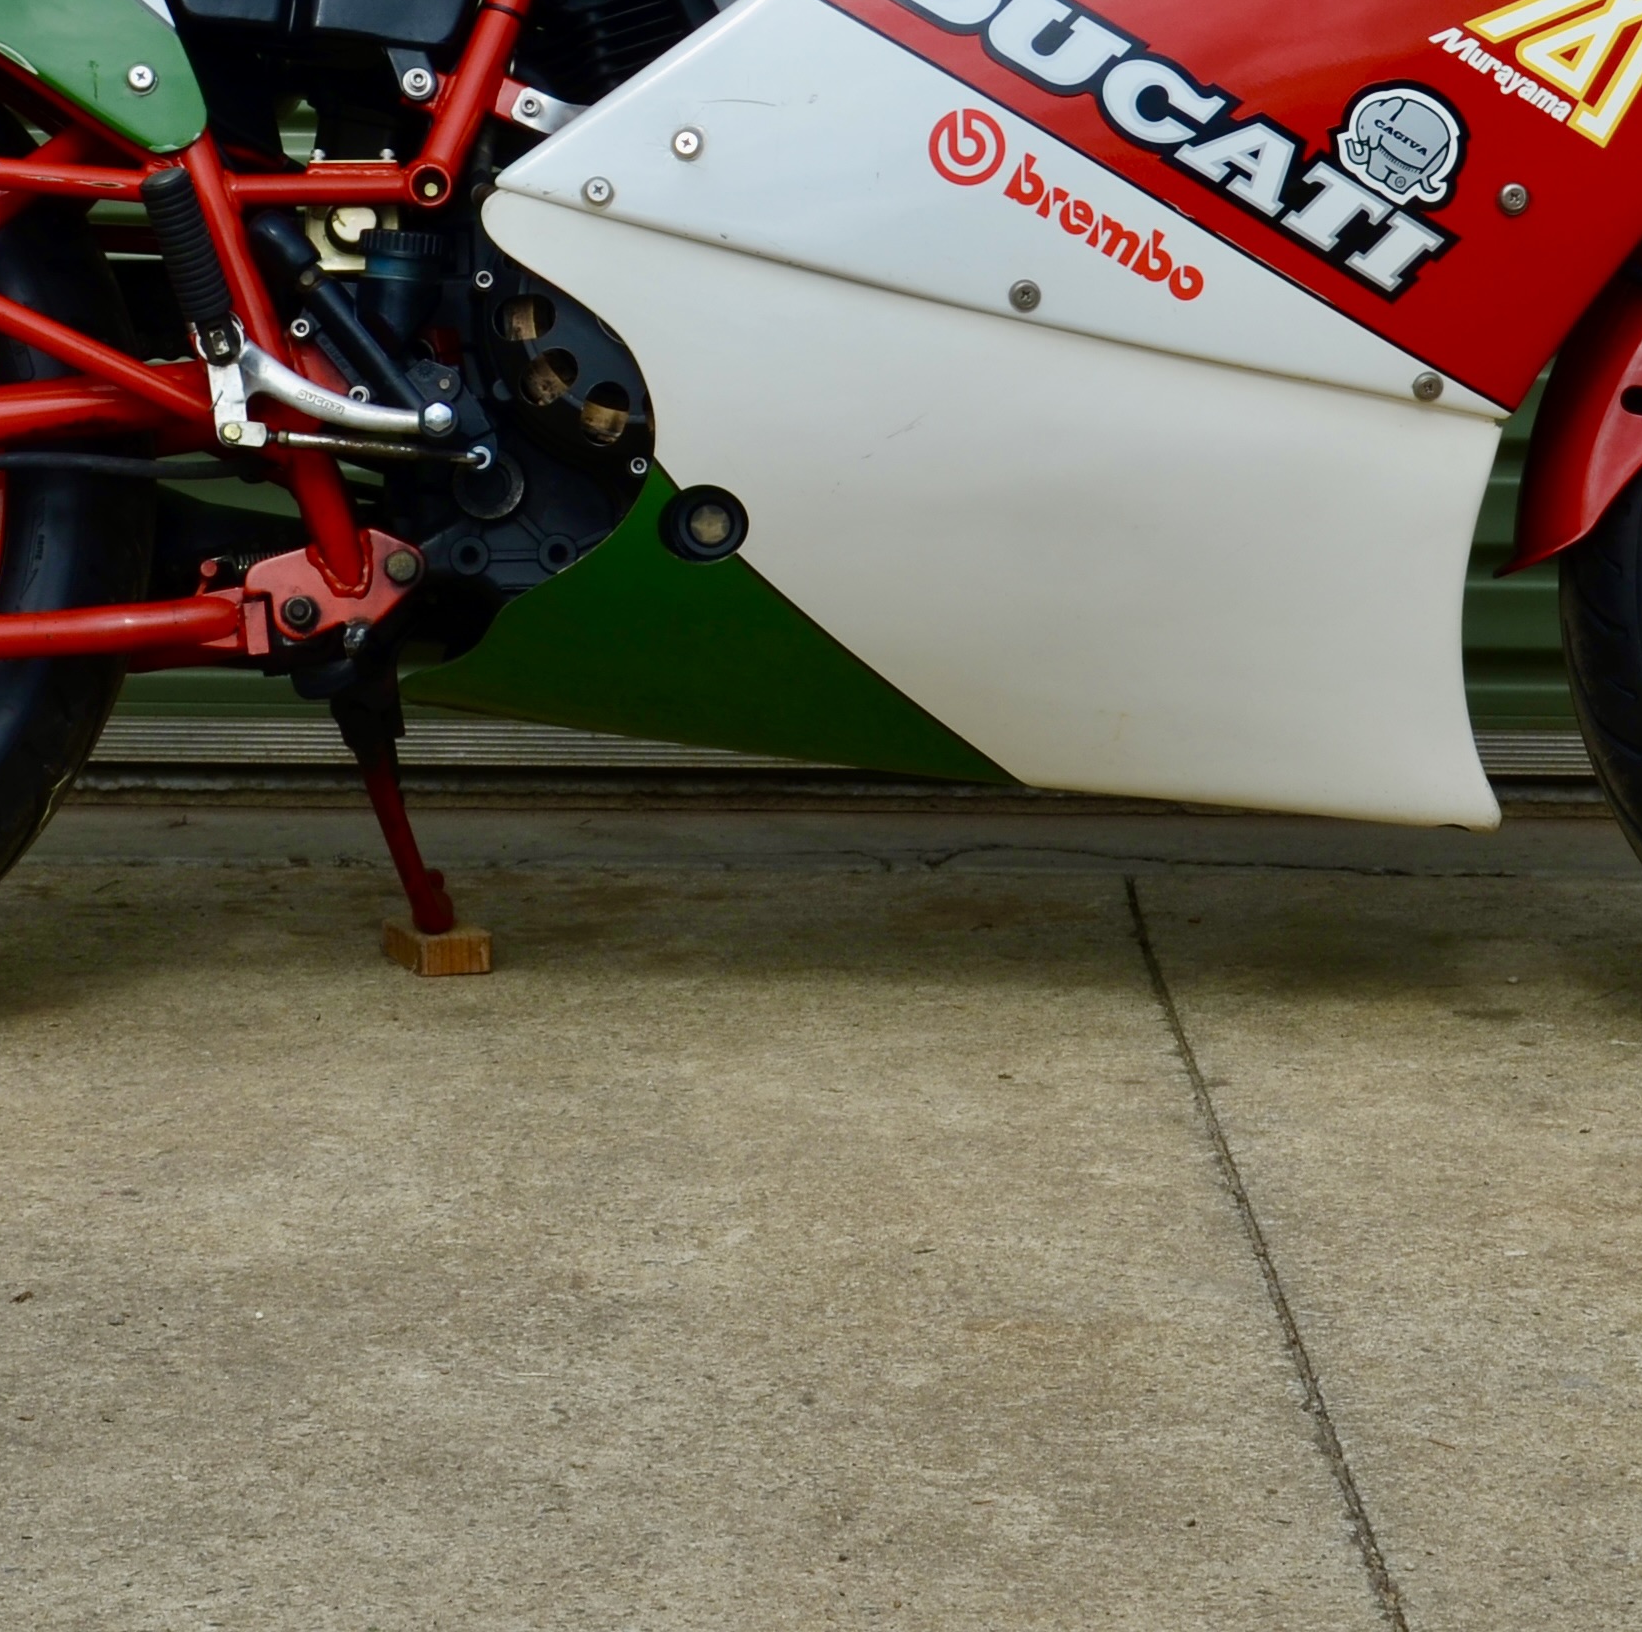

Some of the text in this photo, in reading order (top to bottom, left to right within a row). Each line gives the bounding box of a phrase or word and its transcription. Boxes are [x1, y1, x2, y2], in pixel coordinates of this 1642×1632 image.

[1428, 26, 1574, 123] Murayama
[1374, 118, 1428, 157] CAGIVA
[1002, 151, 1205, 302] brembo
[296, 388, 346, 415] DUCATI
